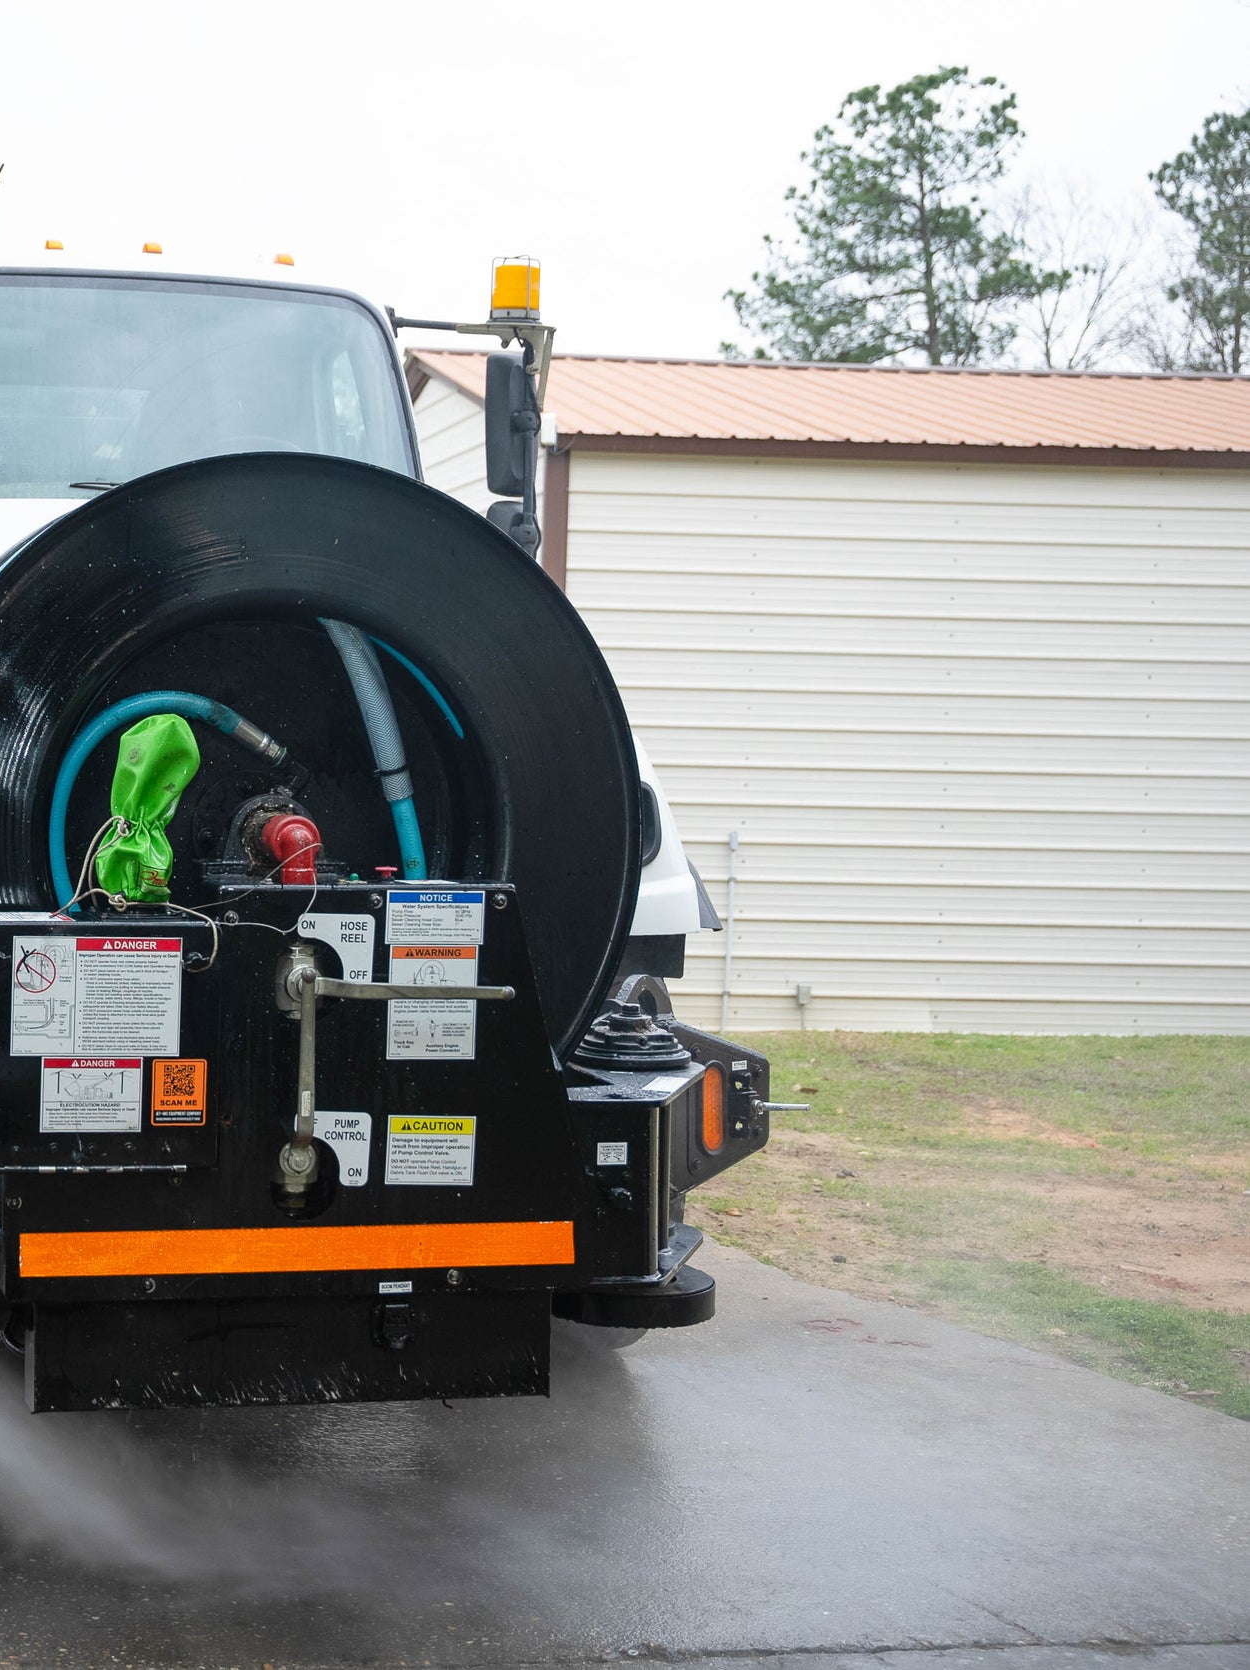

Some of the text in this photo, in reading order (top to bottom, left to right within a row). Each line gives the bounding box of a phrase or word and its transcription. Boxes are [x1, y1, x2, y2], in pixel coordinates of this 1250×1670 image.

[419, 894, 453, 902] NOTICE
[301, 920, 316, 929] ON
[341, 921, 368, 931] HOSE
[341, 934, 367, 943] REEL
[114, 941, 157, 950] DANGER
[415, 949, 462, 957] WARNING
[349, 970, 368, 980] OFF
[334, 1119, 360, 1129] PUMP
[413, 1121, 463, 1131] CAUTION
[324, 1131, 367, 1141] CONTROL
[347, 1168, 362, 1177] ON
